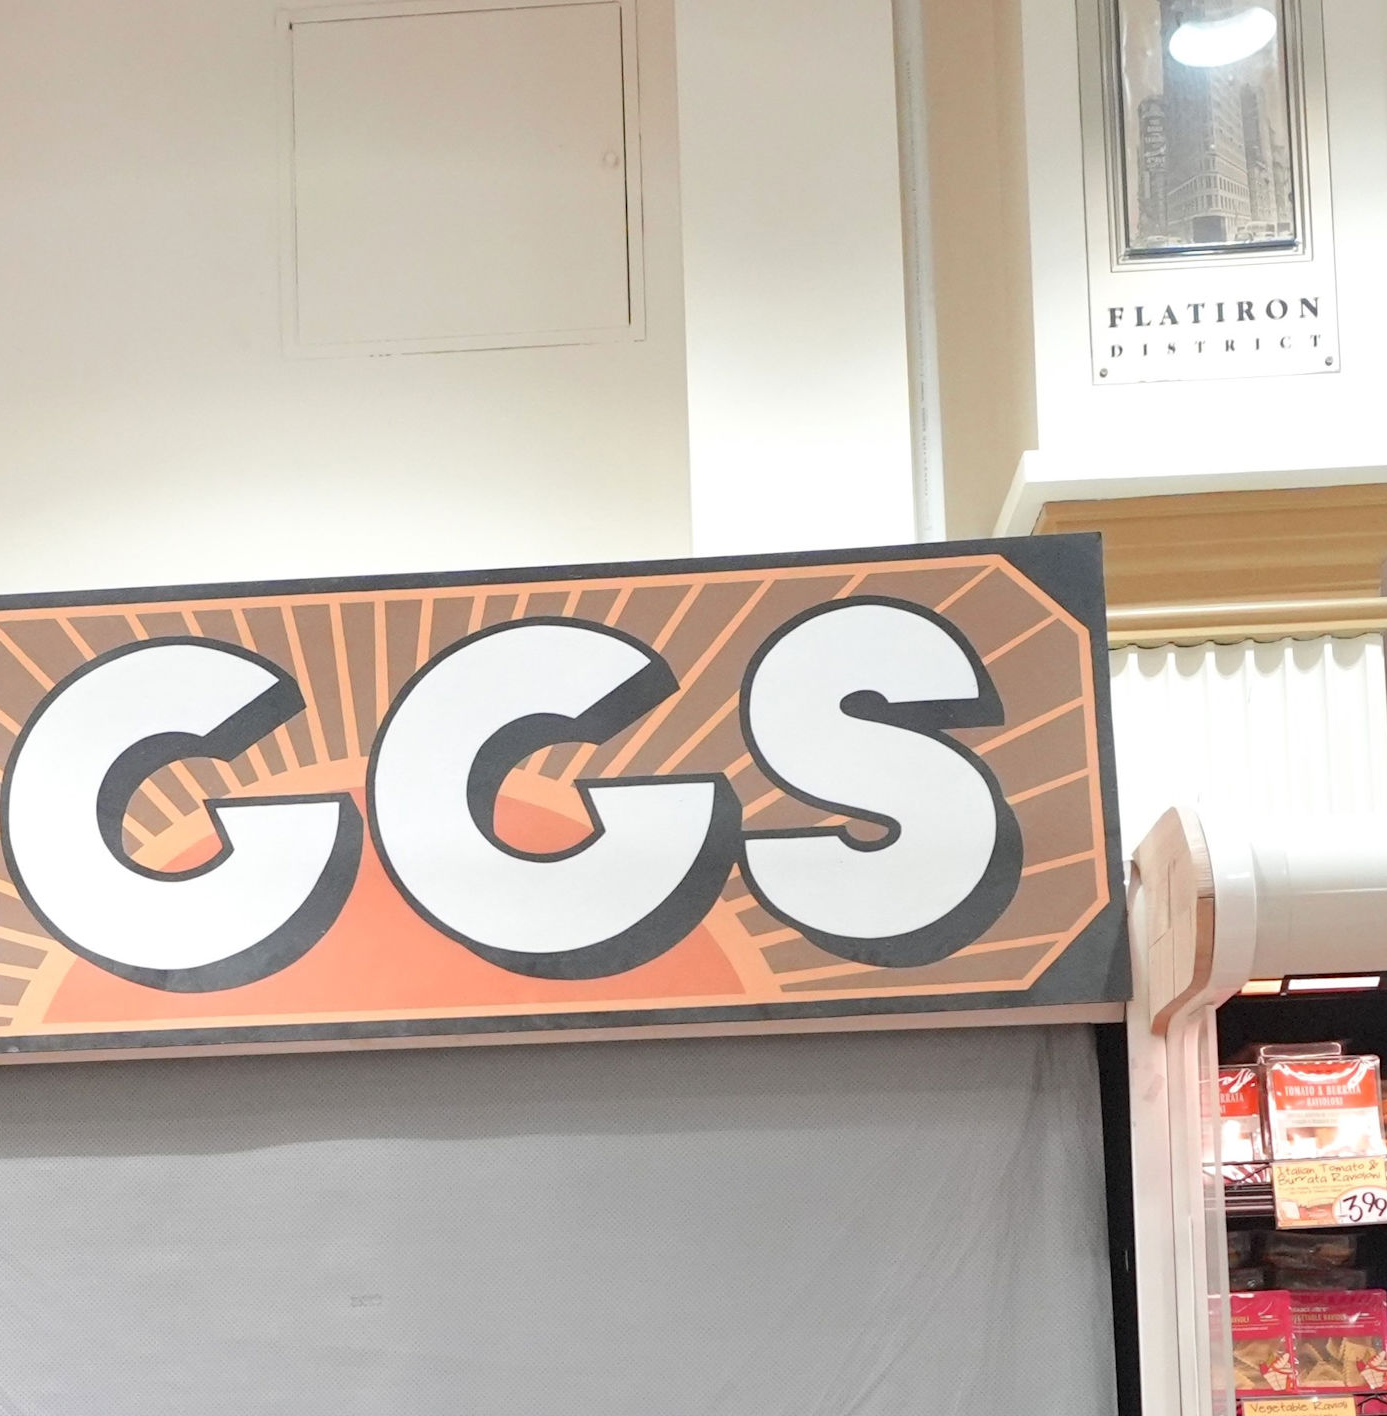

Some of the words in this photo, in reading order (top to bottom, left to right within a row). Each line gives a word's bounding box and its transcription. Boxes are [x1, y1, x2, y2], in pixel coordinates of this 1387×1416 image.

[1107, 297, 1320, 328] FLATIRON
[1111, 334, 1321, 358] DISTRICT
[1277, 1165, 1315, 1177] Italian
[1320, 1163, 1365, 1172] Tomato
[1278, 1173, 1329, 1186] Burrata
[1250, 1401, 1309, 1414] Vegetable
